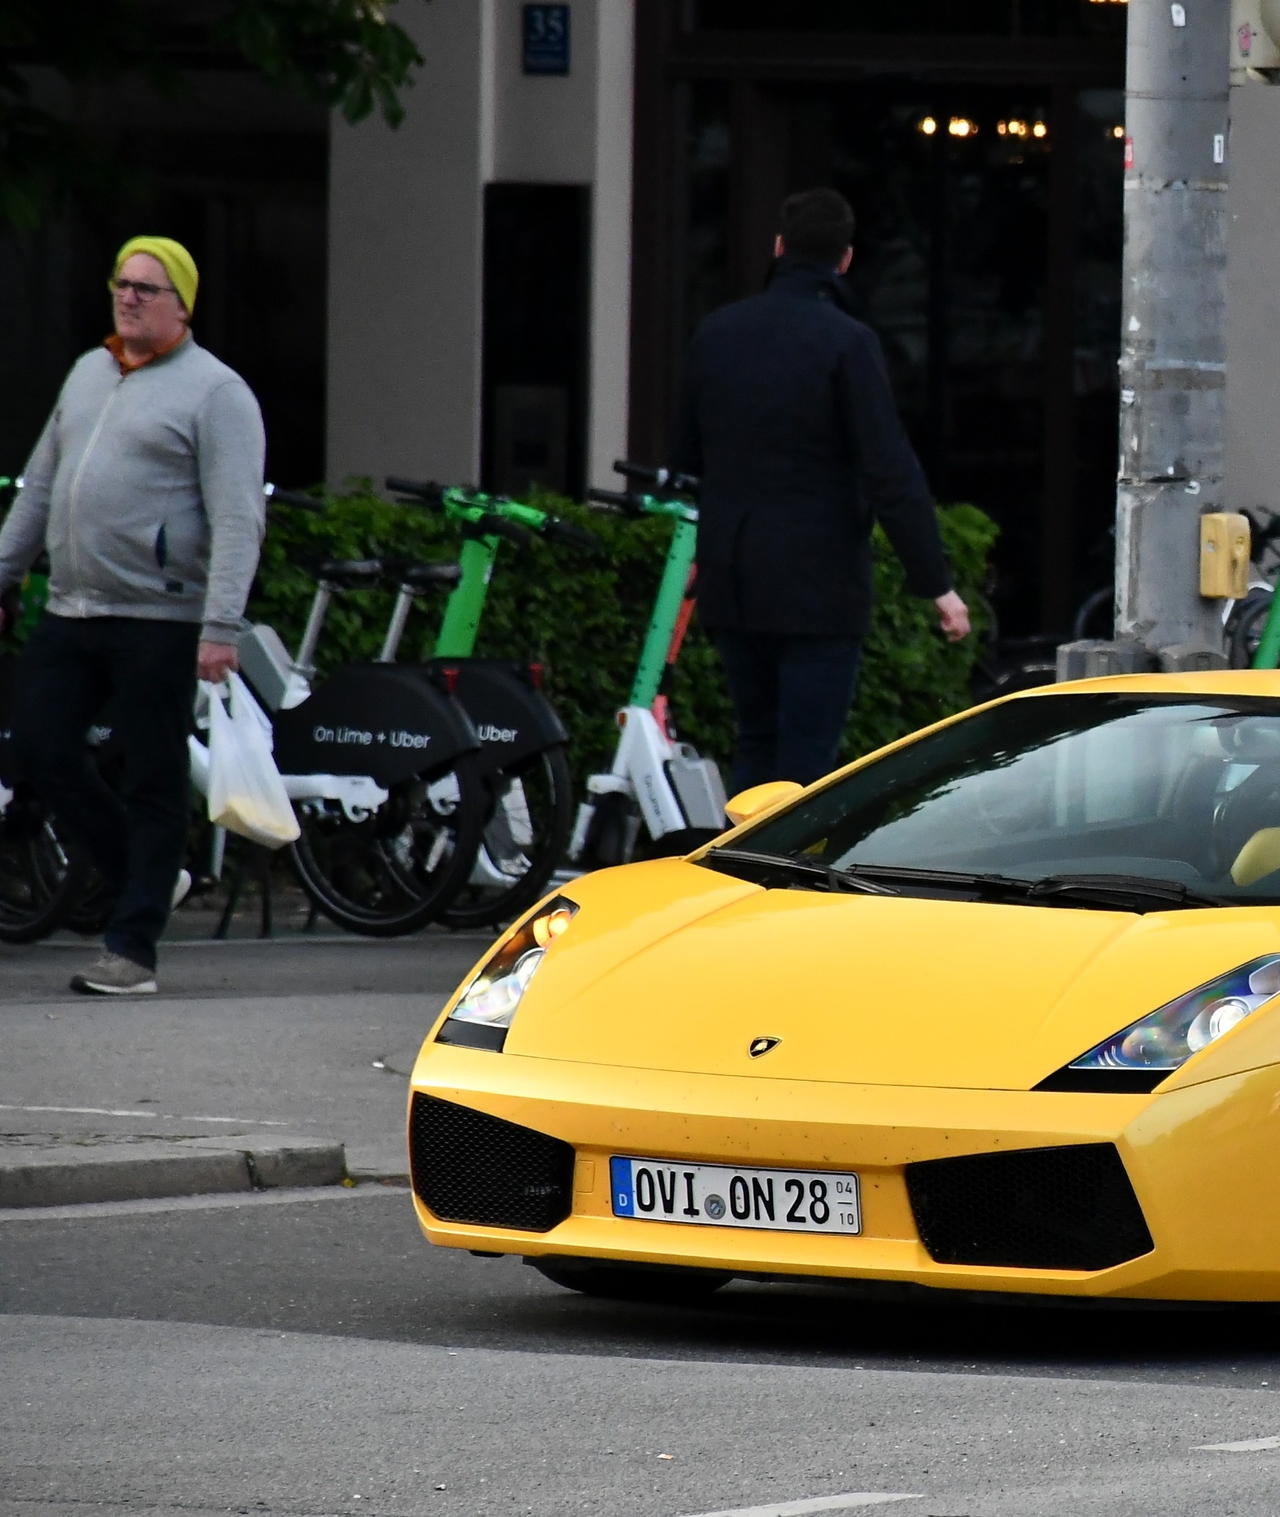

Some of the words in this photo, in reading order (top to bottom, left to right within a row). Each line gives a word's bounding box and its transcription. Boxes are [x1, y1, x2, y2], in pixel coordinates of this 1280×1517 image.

[528, 8, 564, 42] 35
[313, 726, 334, 742] On
[336, 727, 373, 746] Lime
[390, 730, 431, 749] Uber
[477, 724, 518, 743] Uber
[635, 1167, 700, 1216] OVI
[729, 1175, 776, 1221] ON
[785, 1178, 830, 1225] 28
[835, 1181, 853, 1194] 04
[618, 1193, 628, 1206] D
[839, 1212, 855, 1226] 10
